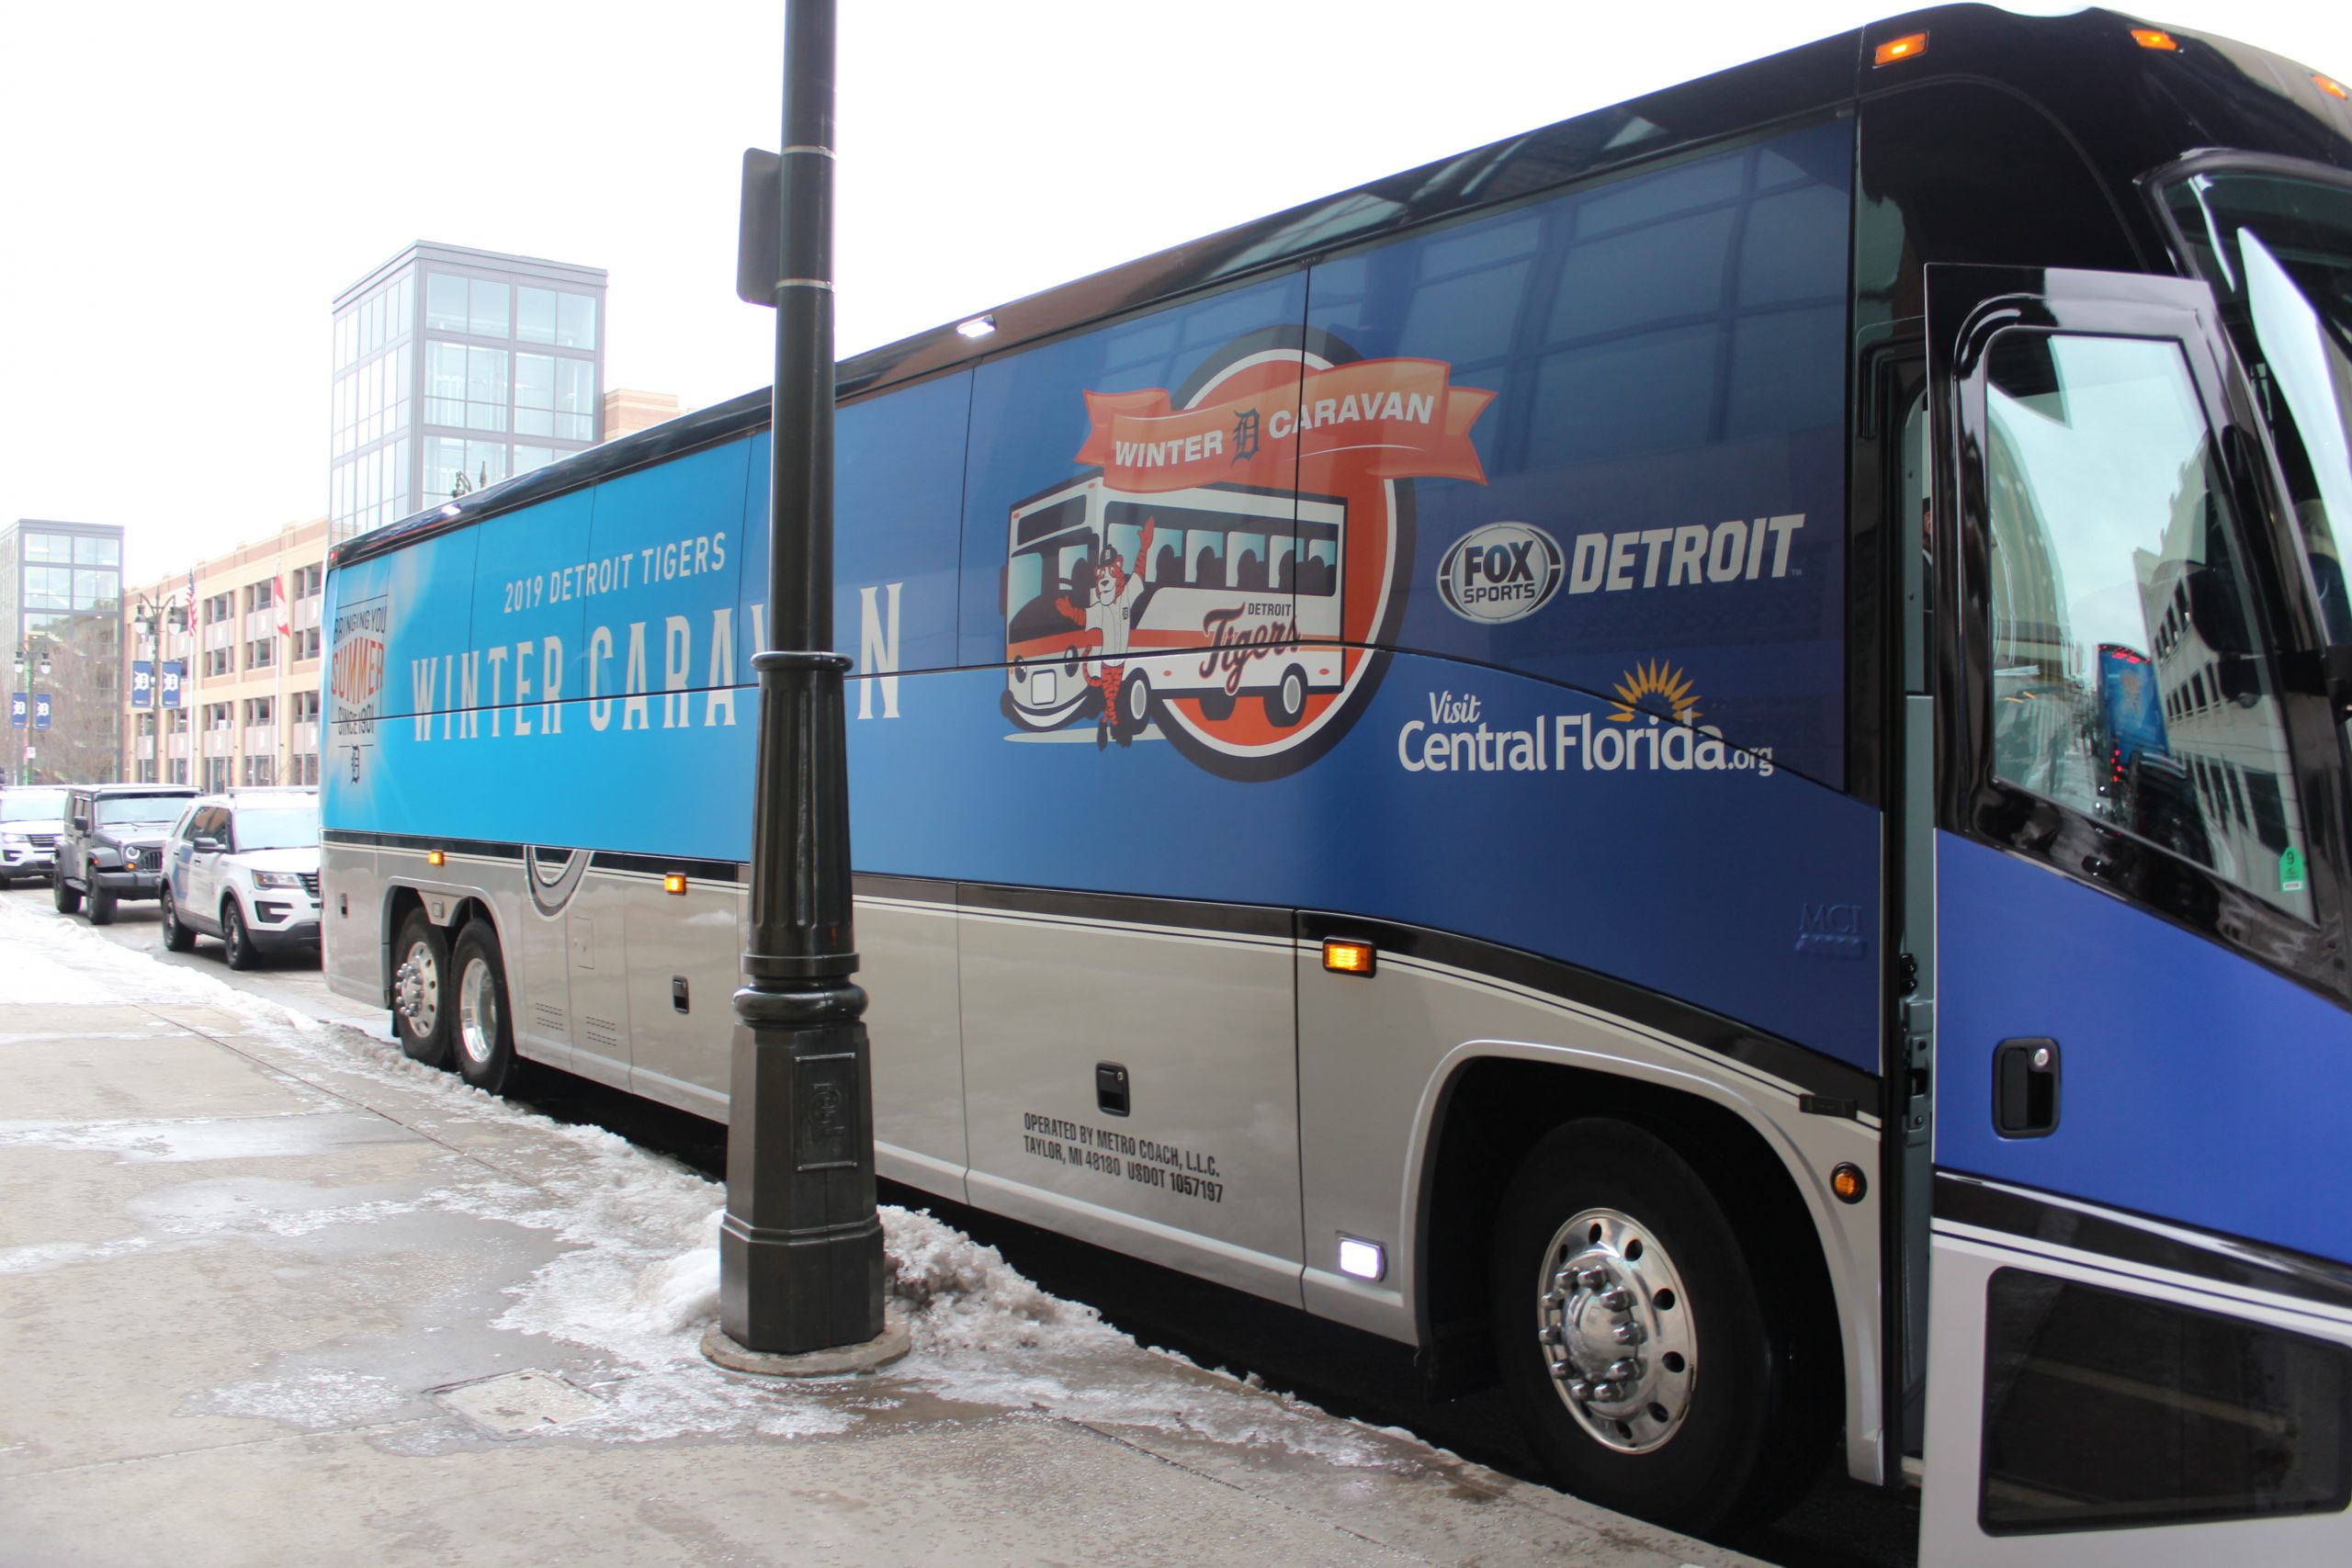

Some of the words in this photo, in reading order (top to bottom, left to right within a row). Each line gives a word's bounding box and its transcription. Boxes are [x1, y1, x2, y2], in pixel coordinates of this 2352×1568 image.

[1115, 429, 1223, 468] WINTER
[1269, 392, 1434, 438] CARAVAN
[504, 575, 543, 614] 2019
[549, 554, 633, 604] DETROIT
[642, 532, 726, 582] TIGERS
[1464, 540, 1534, 587] FOX
[1568, 513, 1805, 594] DETROIT
[334, 609, 370, 645] BRINGING
[371, 605, 387, 634] YOU
[1248, 603, 1292, 616] DETROIT
[1464, 582, 1536, 604] SPORTS
[332, 636, 384, 705] SUMMER
[412, 636, 563, 742] WINTER
[589, 582, 903, 732] CARAN
[1199, 601, 1301, 695] Tigers
[338, 705, 357, 735] SINCE
[358, 703, 374, 734] 1901
[1429, 691, 1482, 724] Visit
[1398, 715, 1548, 772] Central
[1023, 1112, 1076, 1141] OPERATED
[1080, 1125, 1093, 1145] BY
[1096, 1130, 1136, 1156] METRO
[1139, 1139, 1183, 1170] COACH,
[1186, 1150, 1220, 1178] L.L.C.
[1023, 1135, 1066, 1165] TAYLOR,
[1069, 1146, 1082, 1167] MI
[1085, 1150, 1121, 1176] 48180
[1127, 1161, 1165, 1188] USDOT
[1170, 1172, 1223, 1203] 1057197
